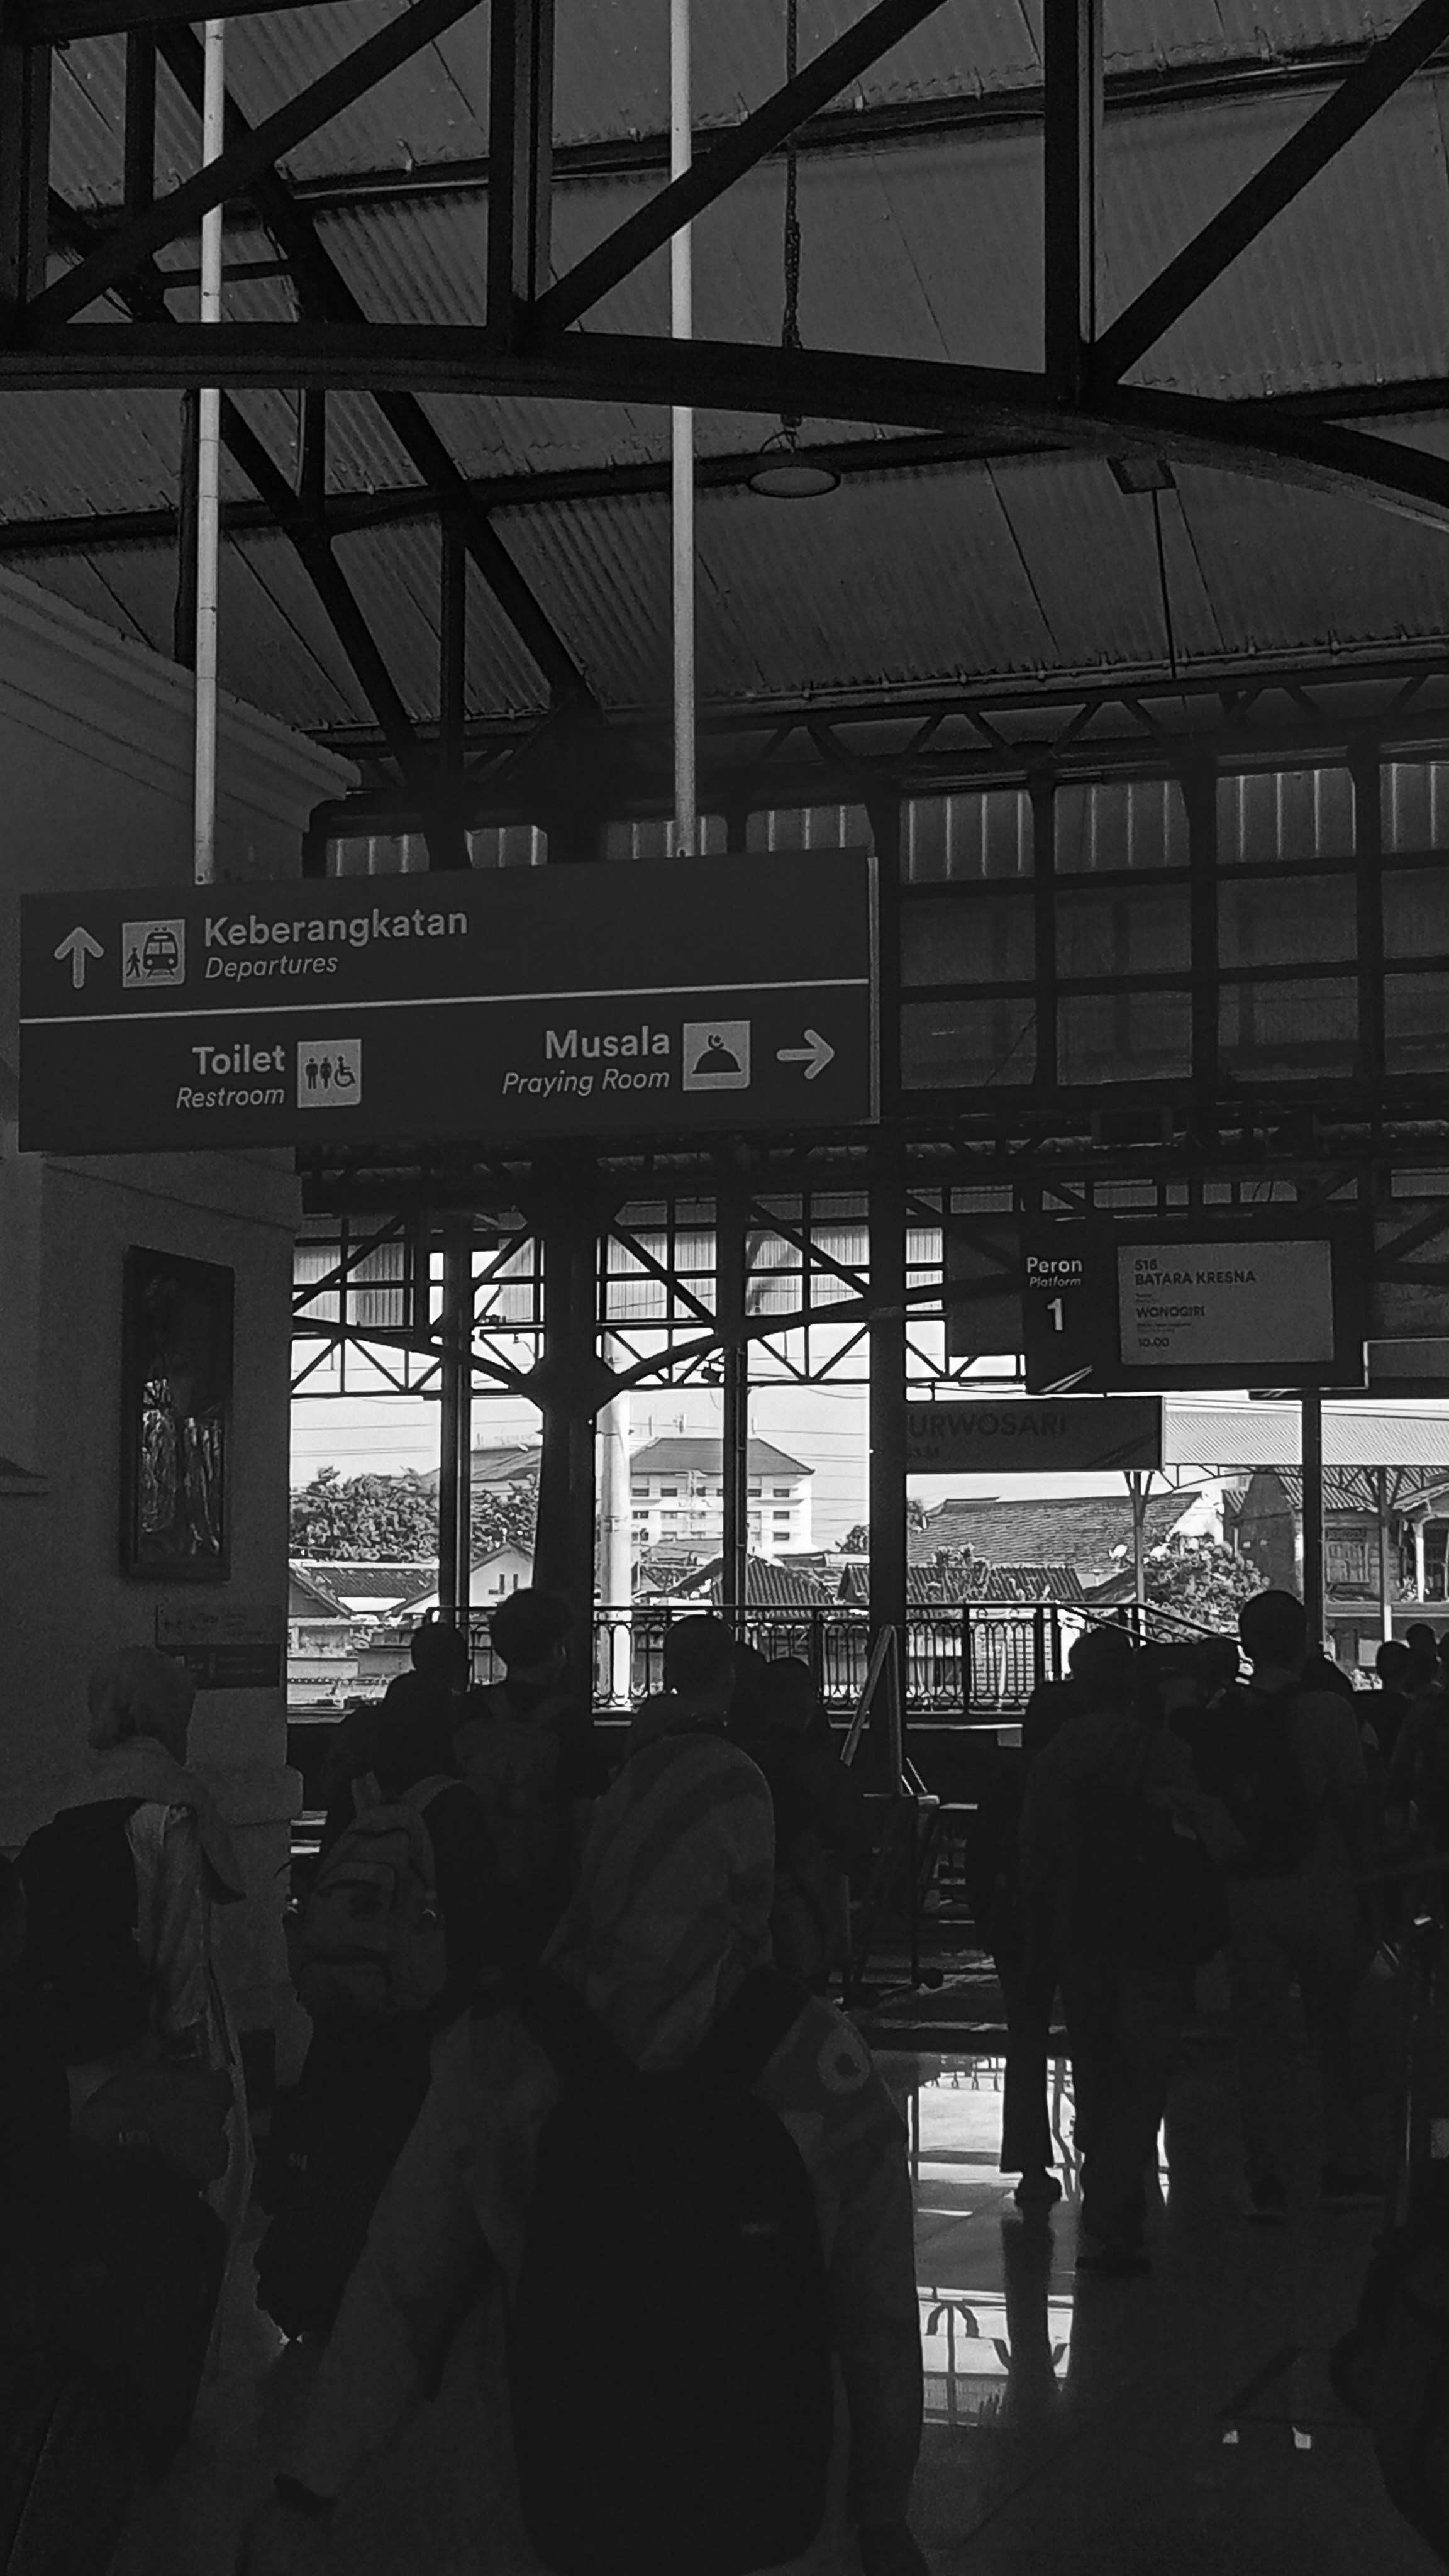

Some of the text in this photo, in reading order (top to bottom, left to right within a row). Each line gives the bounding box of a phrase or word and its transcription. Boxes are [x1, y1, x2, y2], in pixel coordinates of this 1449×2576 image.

[204, 908, 467, 947] Keberangkatan
[204, 955, 339, 982] Departures
[545, 1025, 670, 1060] Musala
[191, 1043, 286, 1075] Toilet
[501, 1068, 670, 1098] Praying Room
[175, 1086, 285, 1109] Restroom
[1026, 1256, 1082, 1274] Peron
[1134, 1258, 1158, 1272] 516
[1134, 1269, 1257, 1287] BATARA KRESNA
[1029, 1275, 1082, 1288] Platform
[1047, 1297, 1064, 1331] 1
[1135, 1305, 1206, 1319] WONOGIRI
[909, 1411, 1067, 1438] URWOSARI
